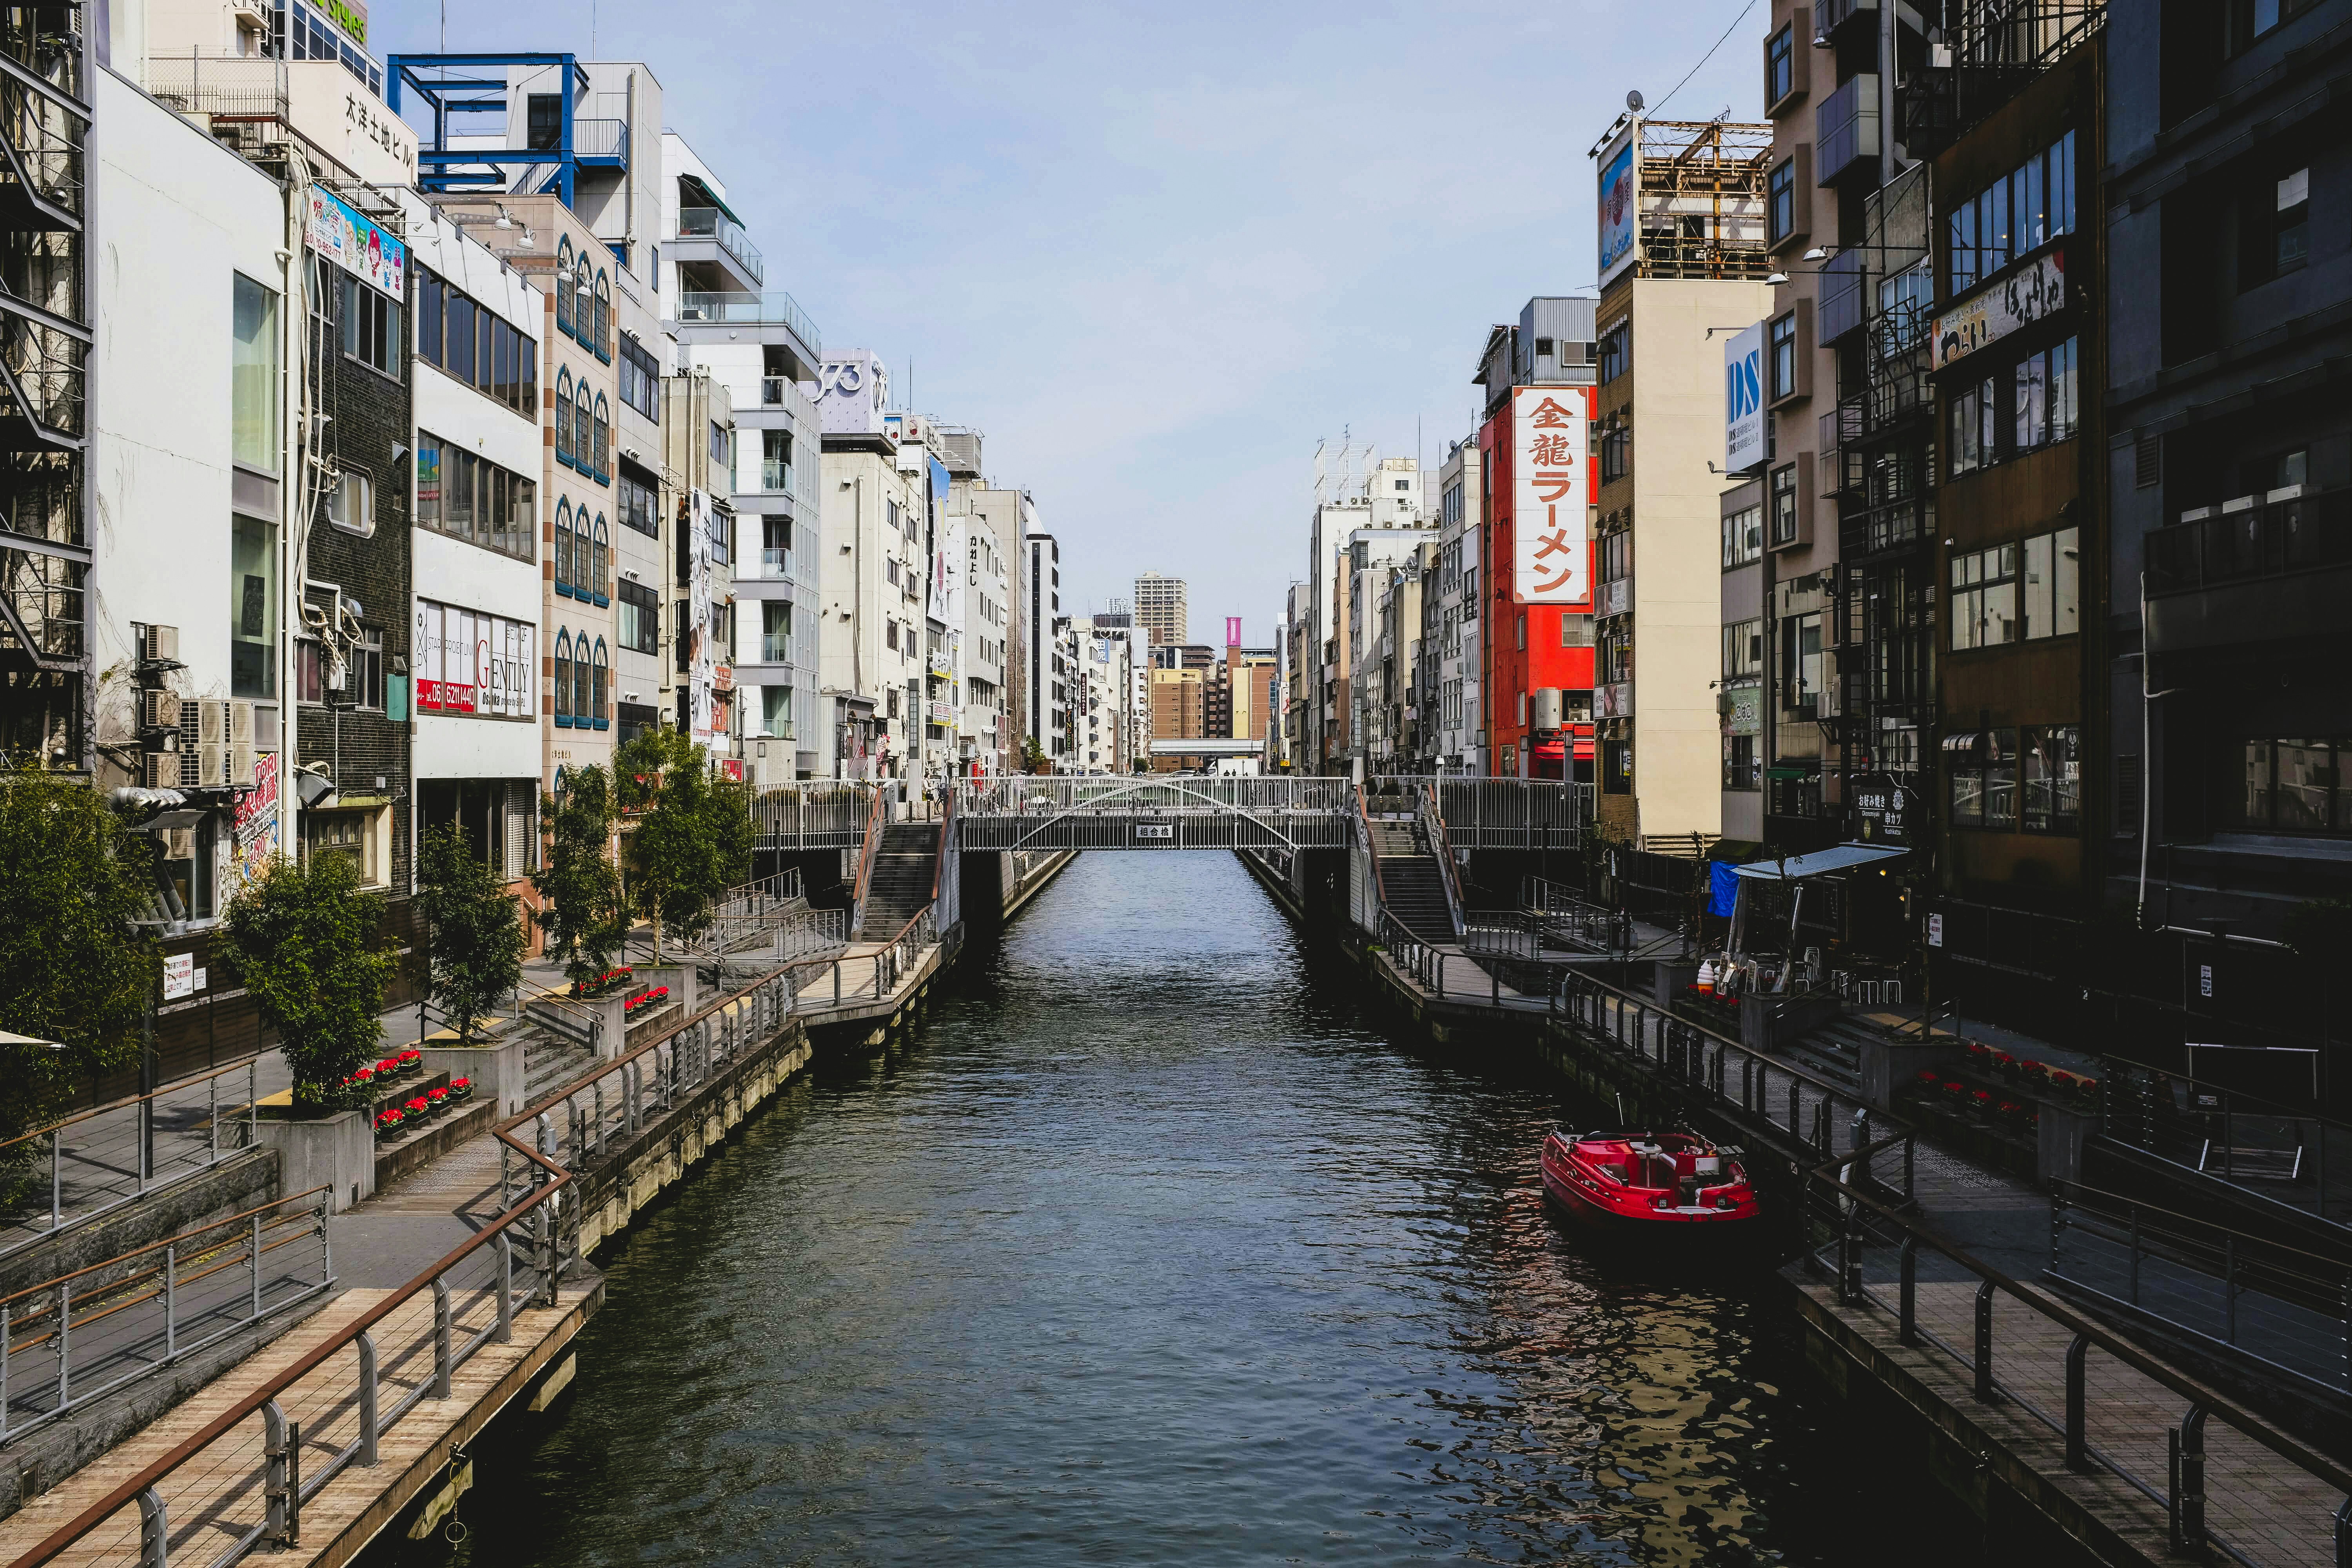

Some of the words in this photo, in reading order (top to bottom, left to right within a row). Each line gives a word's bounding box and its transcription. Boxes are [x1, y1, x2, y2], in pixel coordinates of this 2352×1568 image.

[346, 92, 410, 168] 太洋土地ビル
[1941, 318, 1986, 365] わらい
[1728, 348, 1759, 425] DS
[1729, 428, 1736, 442] DS
[1729, 442, 1736, 456] DS
[1528, 397, 1573, 593] 金龍ラーメン
[522, 627, 527, 641] 2F
[513, 647, 529, 657] cub
[477, 639, 529, 693] GENTLY
[1859, 795, 1885, 808] お好み焼き
[1885, 811, 1901, 825] 串カツ
[1140, 827, 1169, 837] 相合橋
